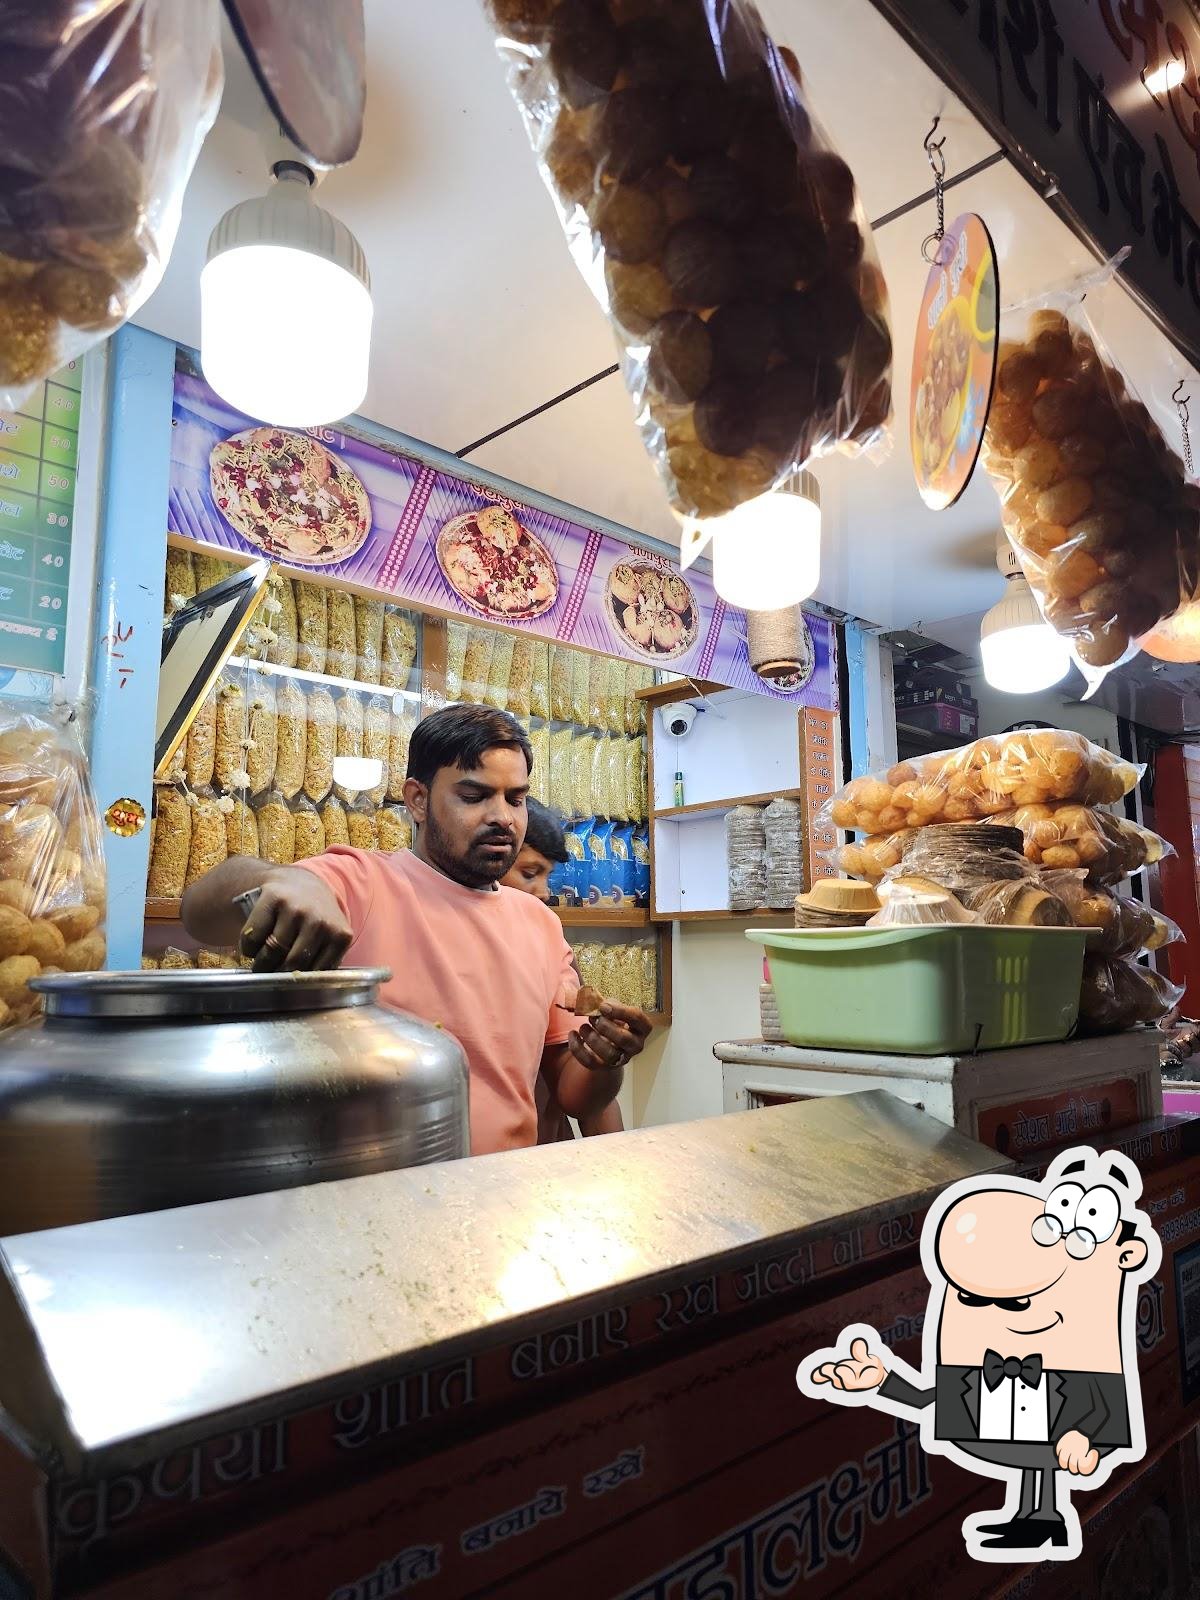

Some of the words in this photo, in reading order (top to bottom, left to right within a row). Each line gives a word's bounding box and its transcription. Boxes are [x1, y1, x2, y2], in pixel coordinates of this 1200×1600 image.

[48, 475, 70, 490] 50
[46, 512, 69, 527] 30
[41, 553, 64, 567] 40
[39, 595, 62, 610] 20
